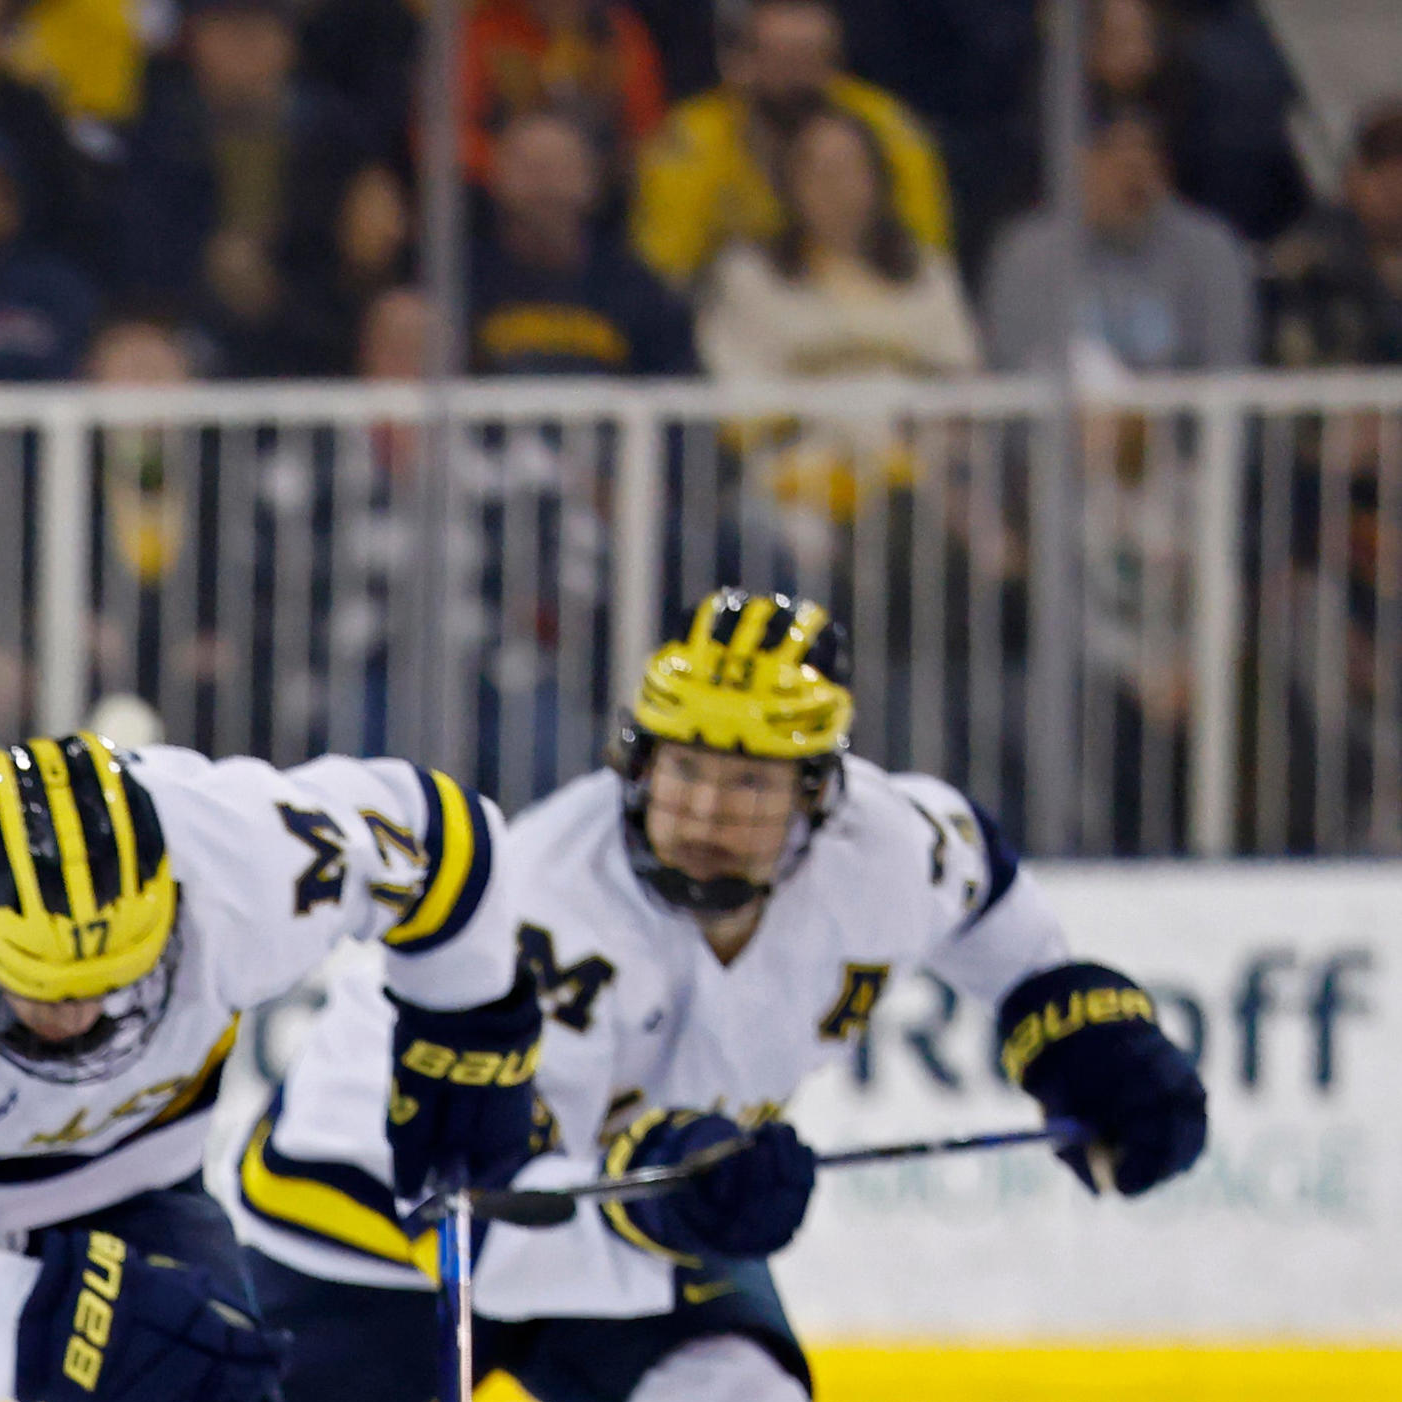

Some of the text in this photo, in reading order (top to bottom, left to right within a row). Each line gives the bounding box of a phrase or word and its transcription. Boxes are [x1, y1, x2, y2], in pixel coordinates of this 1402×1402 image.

[273, 803, 349, 919] M
[71, 920, 111, 960] 17
[514, 919, 618, 1037] M
[818, 963, 891, 1043] A
